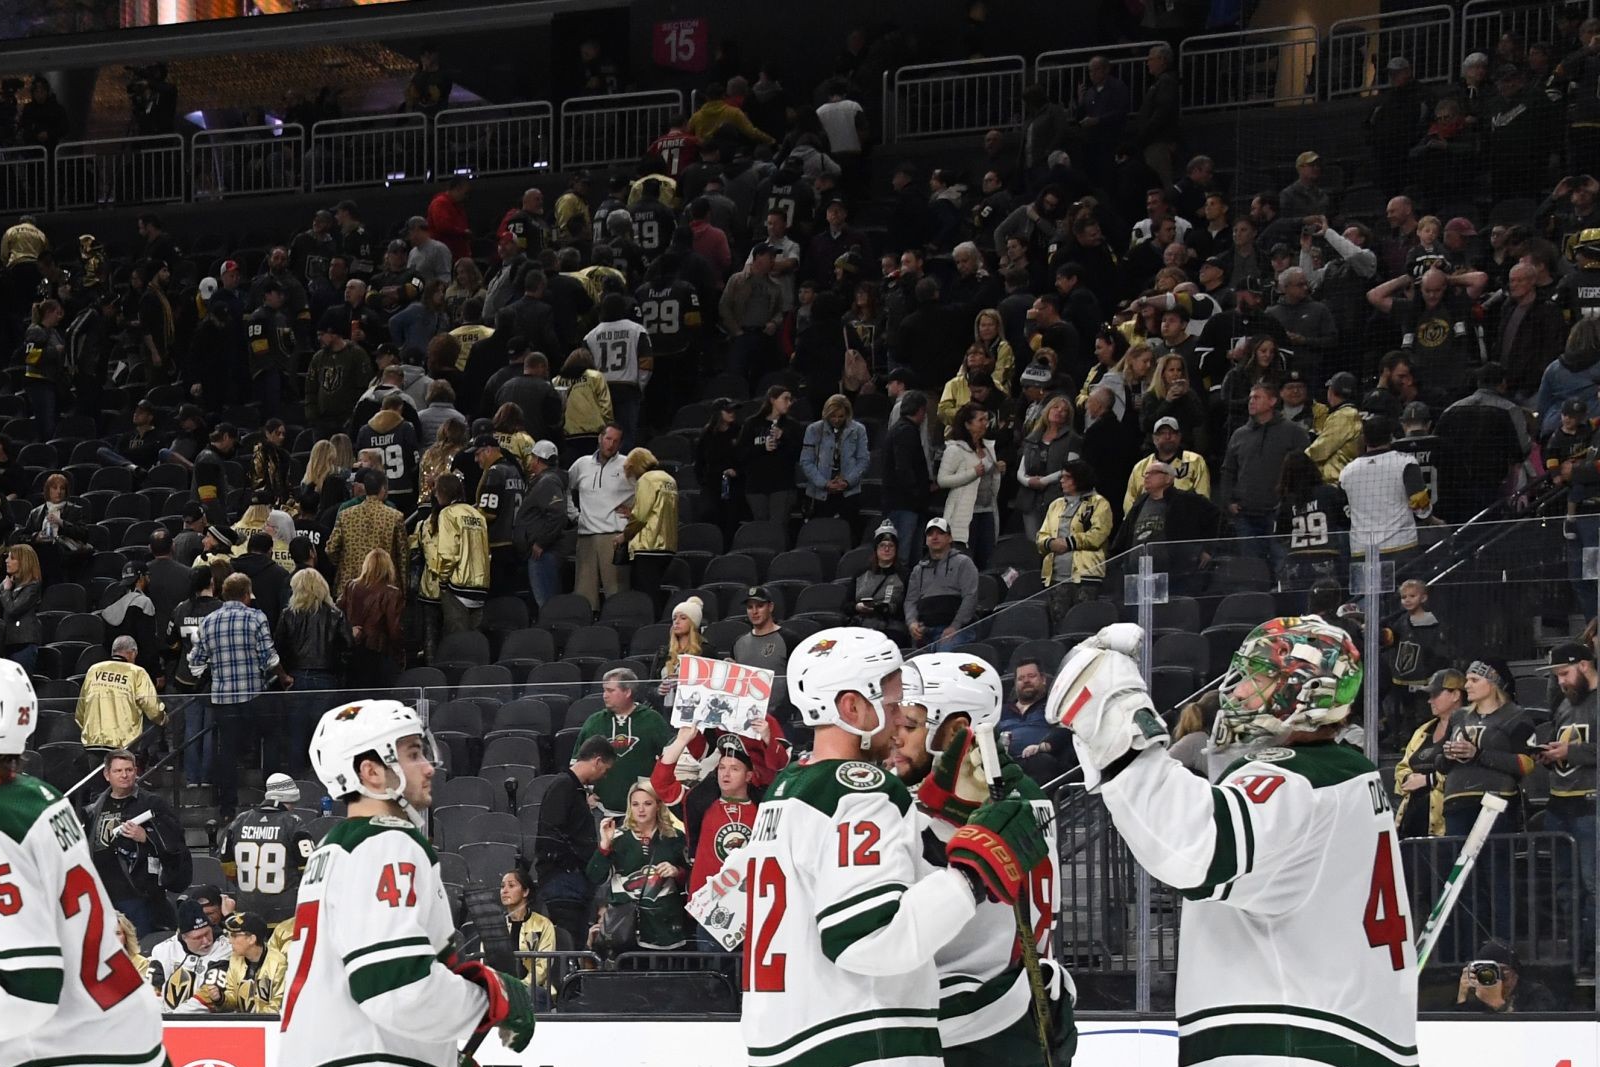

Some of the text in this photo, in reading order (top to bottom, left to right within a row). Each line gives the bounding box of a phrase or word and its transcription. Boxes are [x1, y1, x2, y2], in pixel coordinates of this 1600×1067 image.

[662, 19, 700, 31] SECTION
[665, 29, 696, 63] 15
[640, 299, 681, 334] 29
[598, 341, 629, 373] 13
[1290, 511, 1330, 549] 29
[95, 671, 129, 685] VEGAS
[679, 656, 772, 701] DUBS
[17, 706, 31, 726] 25
[240, 825, 281, 841] SCHMIDT
[836, 820, 881, 869] 12
[234, 841, 287, 894] 88
[375, 862, 417, 908] 47
[740, 857, 788, 992] 12
